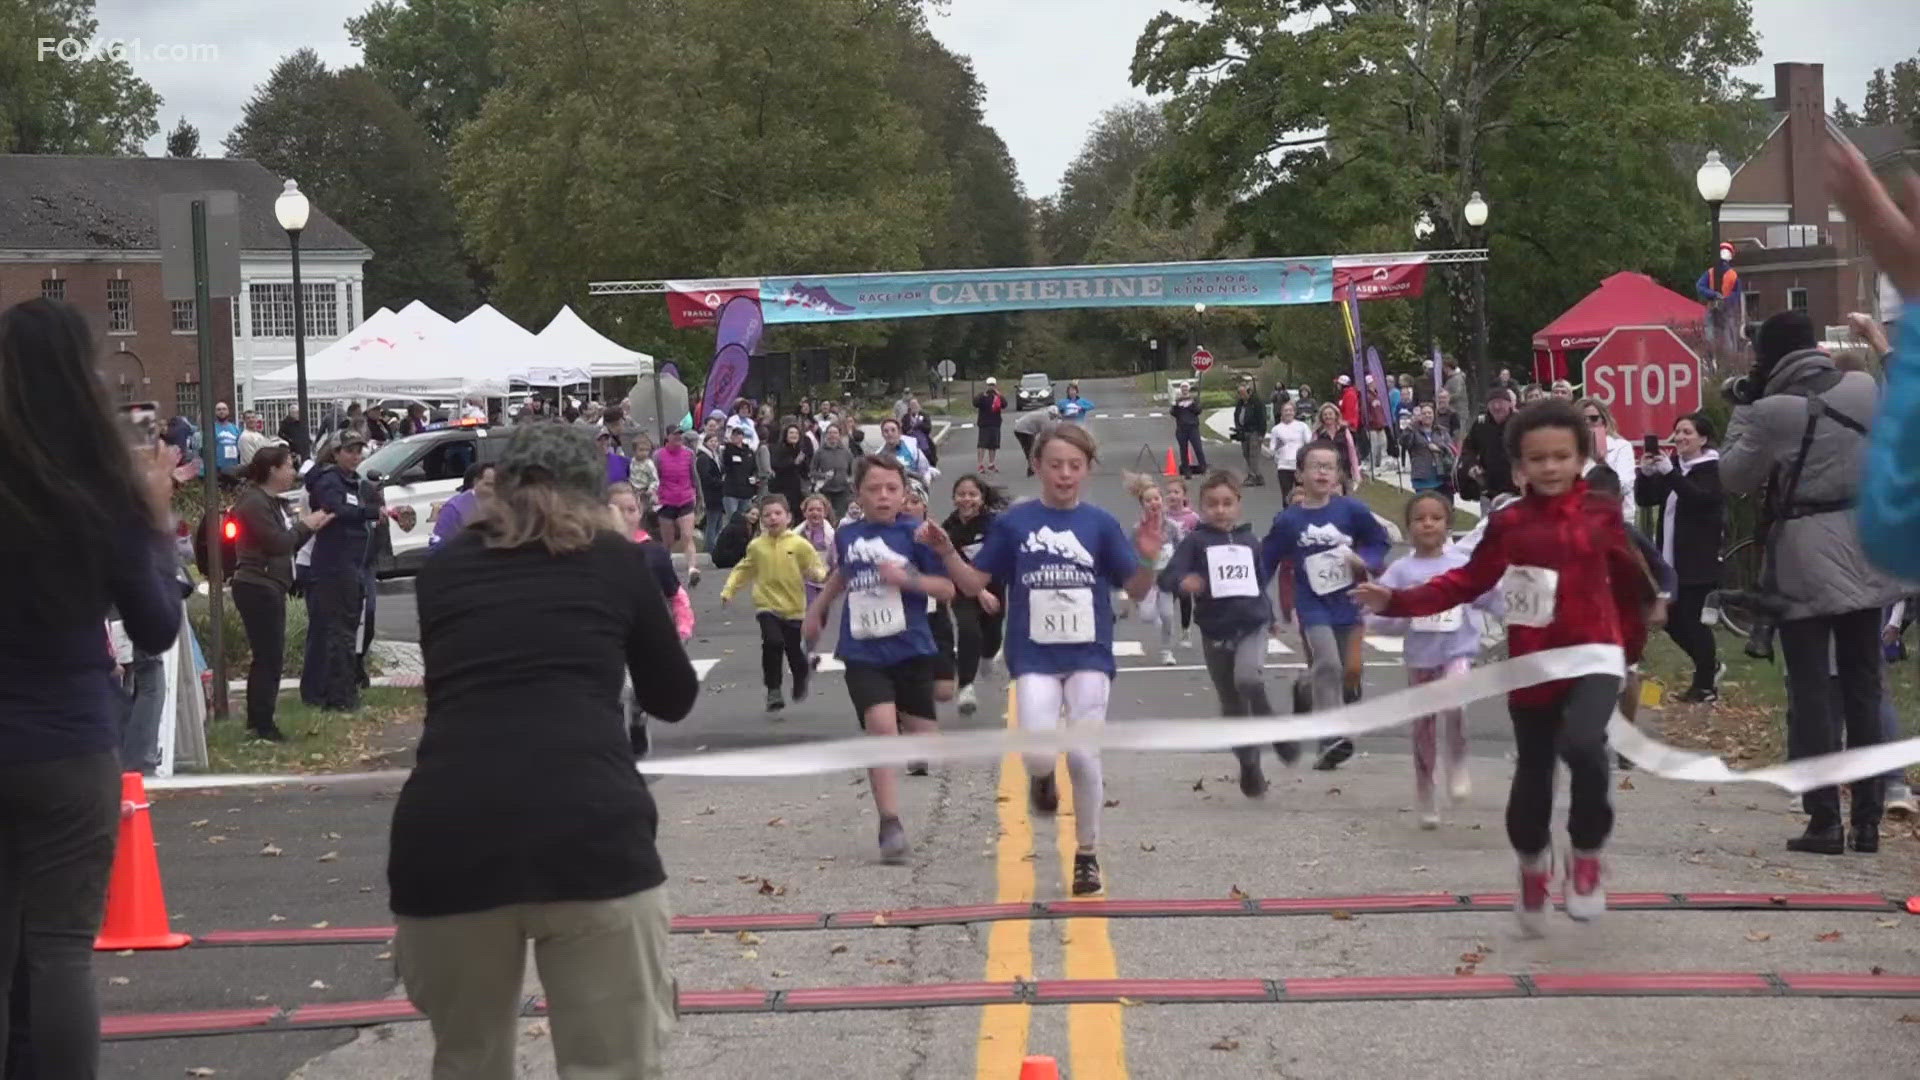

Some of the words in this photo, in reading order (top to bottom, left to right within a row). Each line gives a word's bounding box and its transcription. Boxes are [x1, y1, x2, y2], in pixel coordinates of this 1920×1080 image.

[858, 293, 891, 303] RACE
[929, 276, 1163, 305] CATHERINE
[1174, 285, 1259, 295] KINDNESS
[1193, 356, 1211, 365] STOP
[1593, 364, 1692, 406] STOP
[1217, 565, 1249, 580] 1237
[1504, 592, 1539, 614] 581
[860, 608, 892, 628] 810
[1044, 614, 1078, 632] 811
